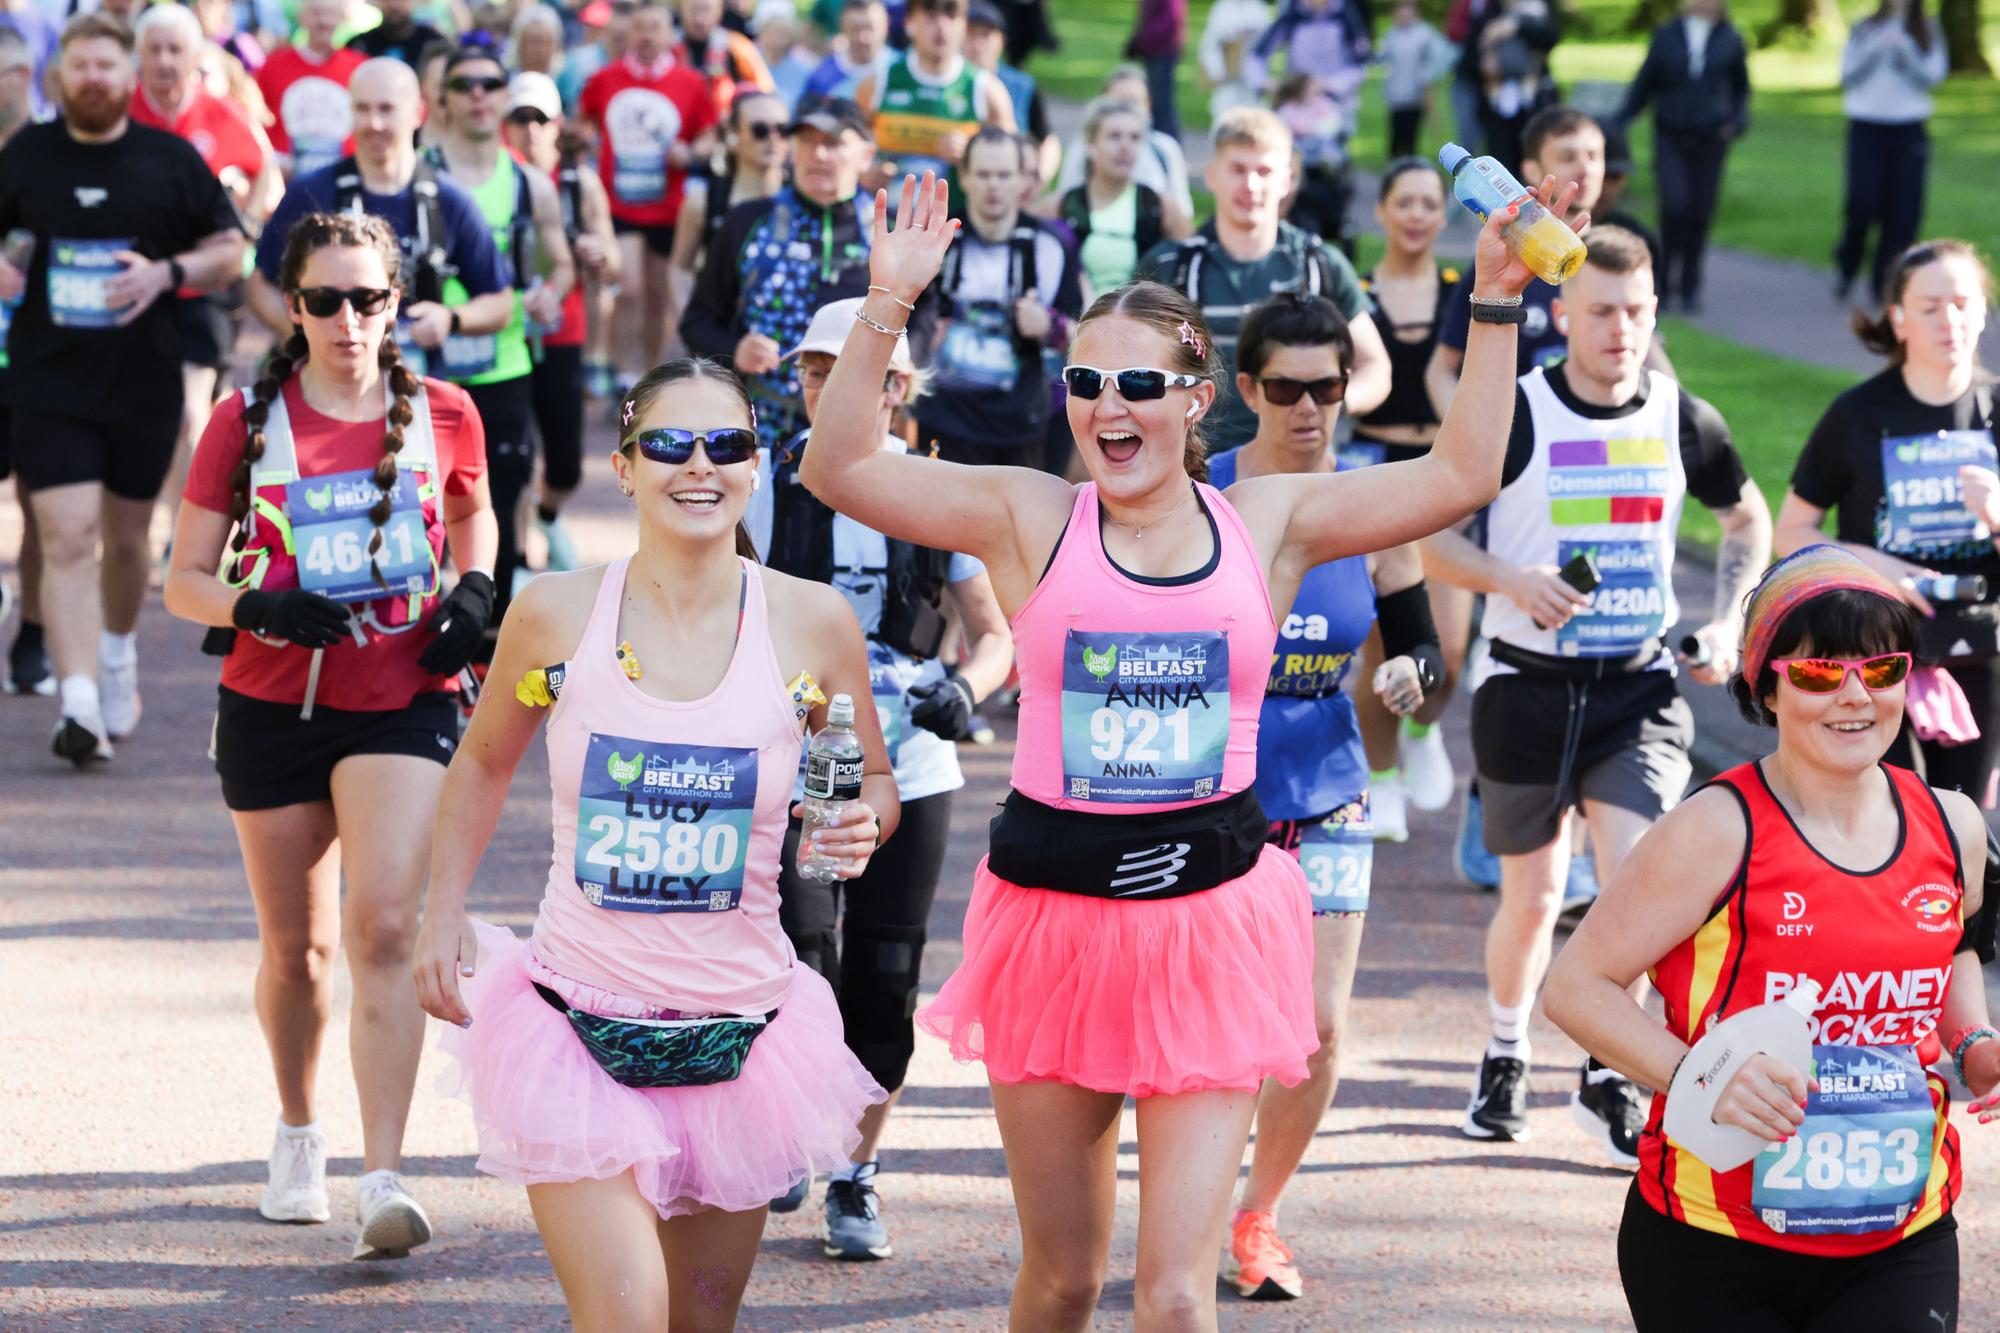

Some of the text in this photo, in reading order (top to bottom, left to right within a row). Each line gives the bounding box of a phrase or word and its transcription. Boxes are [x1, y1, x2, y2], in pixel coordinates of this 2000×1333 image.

[1548, 471, 1645, 493] Dementia
[333, 486, 401, 507] BELFAT
[305, 523, 414, 576] 4641
[1280, 614, 1329, 641] ca
[1088, 664, 1110, 674] park
[1119, 660, 1207, 676] BELFAST
[1119, 675, 1207, 685] CITY MARATHON 2025
[1105, 681, 1211, 711] ANNA
[1090, 708, 1190, 761] 921
[612, 769, 635, 781] park
[643, 770, 735, 792] BELFAST
[642, 786, 663, 795] CITY
[664, 787, 712, 799] MARATHON
[1090, 787, 1194, 797] www.belfastcitymarathon.com
[625, 793, 711, 823] LUCY
[586, 814, 738, 875] 2580
[609, 867, 711, 900] LUCY
[603, 894, 709, 906] www.belfastcitymarathon.com
[1776, 924, 1814, 937] DEFY
[1819, 1073, 1906, 1094] BELFAST
[1820, 1094, 1839, 1103] CITY
[1842, 1093, 1888, 1102] MARATHON
[1763, 1128, 1920, 1190] 2853
